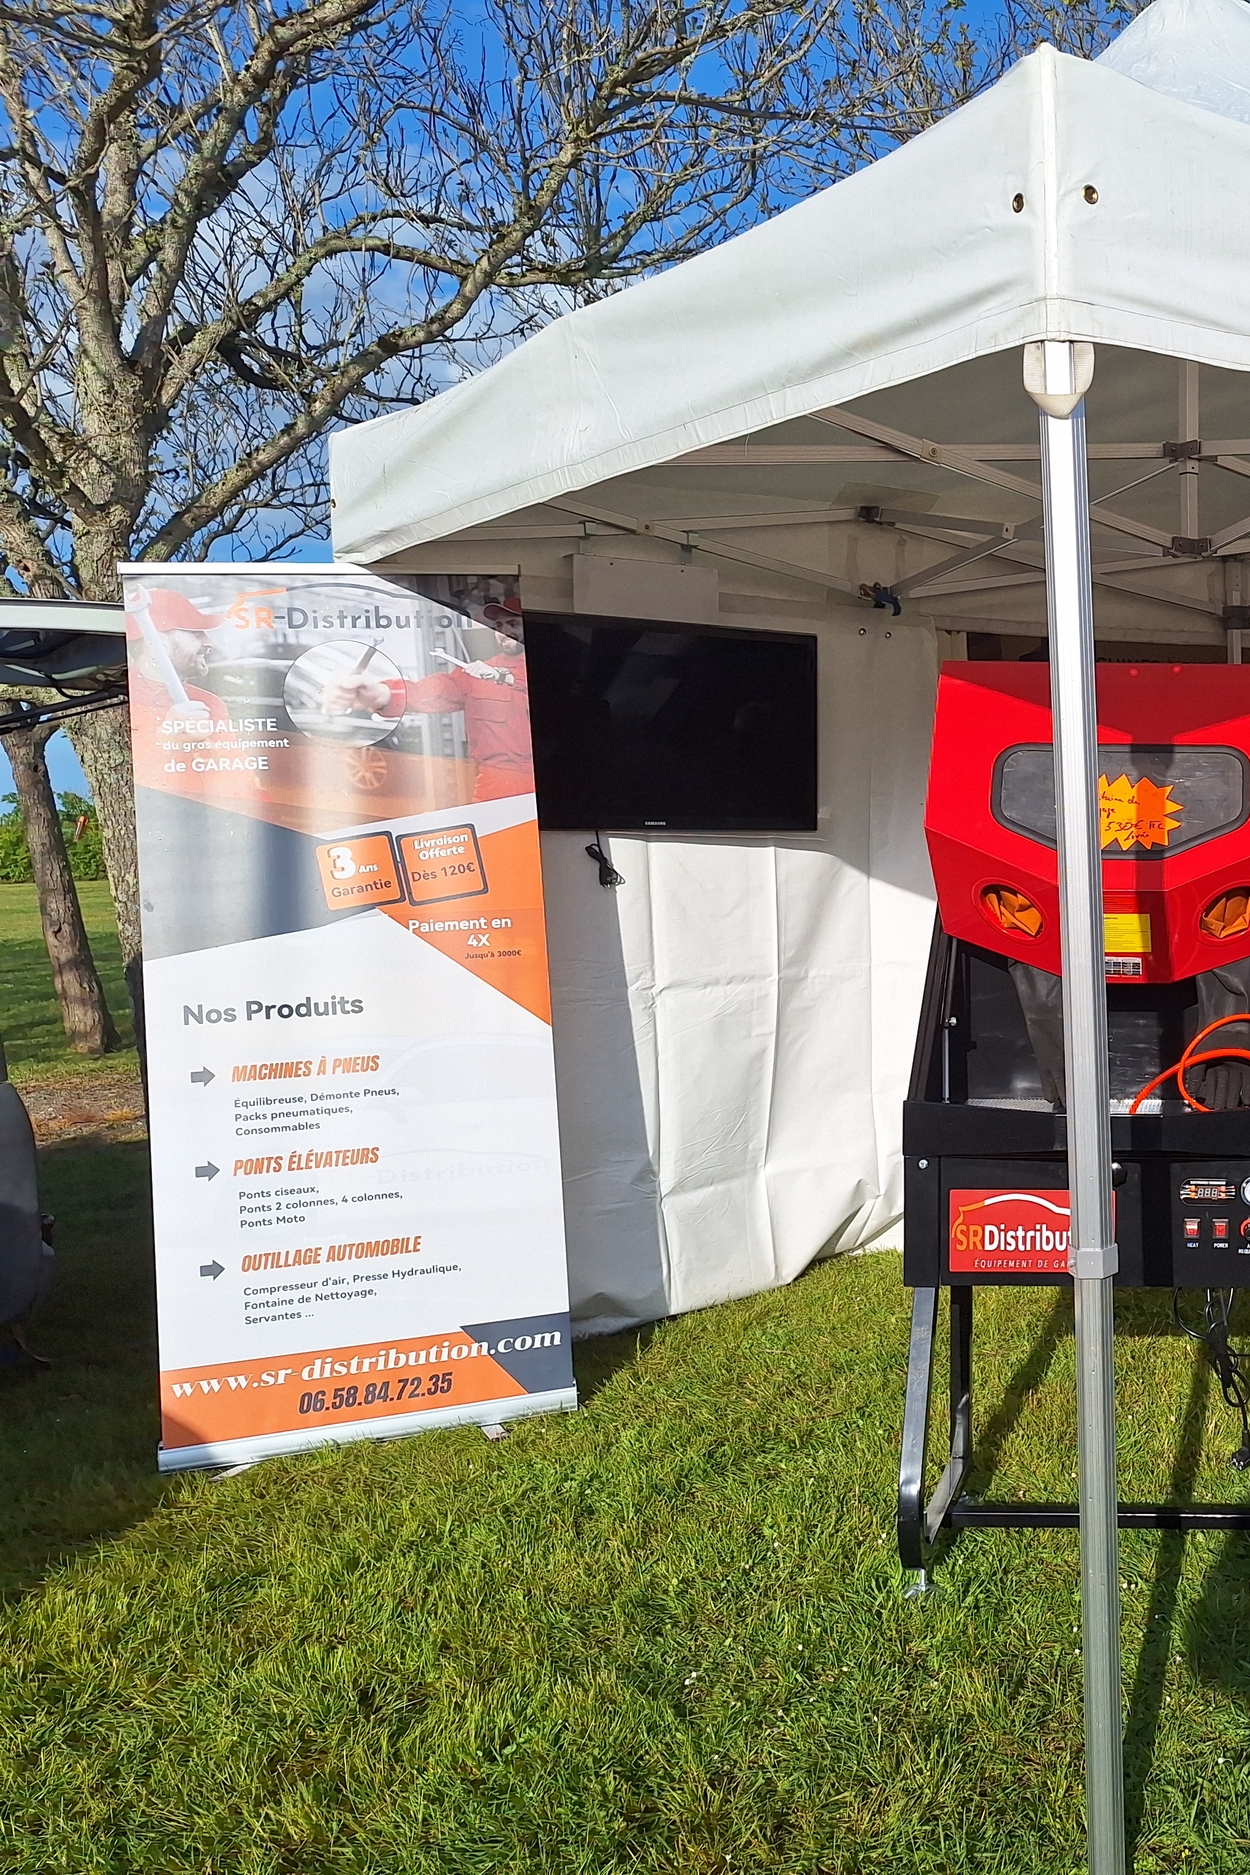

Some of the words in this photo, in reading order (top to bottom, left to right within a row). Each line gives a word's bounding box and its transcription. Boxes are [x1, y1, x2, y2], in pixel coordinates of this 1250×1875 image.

[233, 605, 473, 630] SR-Distribution
[161, 716, 278, 734] SPÉCIALISTE
[163, 740, 179, 751] du
[183, 741, 212, 753] gros
[214, 737, 290, 751] équipement
[164, 759, 186, 773] de
[191, 756, 270, 772] GARAGE
[413, 833, 468, 850] Livraison
[418, 845, 466, 861] Offerte
[328, 846, 356, 880] 3
[358, 863, 379, 874] Ans
[411, 868, 438, 883] Dès
[441, 862, 476, 877] 120€
[331, 879, 392, 898] Garantie
[408, 916, 488, 933] Paiement
[491, 917, 512, 928] en
[467, 933, 491, 948] 4X
[465, 951, 495, 960] Jusqu'à
[497, 949, 522, 958] 3000€
[182, 1004, 237, 1026] Nos
[246, 995, 364, 1021] Produits
[231, 1060, 314, 1083] MACHINES
[316, 1055, 328, 1076] À
[332, 1054, 380, 1075] PNEUS
[234, 1095, 307, 1110] Équilibreuse,
[310, 1090, 361, 1103] Démonte
[363, 1087, 400, 1098] Pneus,
[235, 1110, 268, 1123] Packs
[270, 1104, 353, 1122] pneumatiques,
[235, 1121, 321, 1136] Consommables
[232, 1155, 284, 1177] PONTS
[287, 1146, 380, 1172] ÉLÉVATEURS
[238, 1189, 272, 1200] Ponts
[274, 1185, 320, 1197] ciseaux,
[239, 1204, 272, 1215] Ponts
[275, 1202, 283, 1211] 2
[285, 1197, 339, 1210] colonnes,
[341, 1195, 349, 1204] 4
[351, 1191, 403, 1203] colonnes,
[240, 1218, 273, 1229] Ponts
[276, 1215, 306, 1225] Moto
[955, 1224, 1071, 1251] SRDistribu
[241, 1247, 323, 1273] OUTILLAGE
[325, 1235, 422, 1263] AUTOMOBILE
[974, 1257, 1033, 1269] ÉQUIPEMENT
[1037, 1259, 1049, 1268] DE
[243, 1279, 319, 1297] Compresseur
[321, 1276, 350, 1288] d'air,
[352, 1272, 389, 1284] Presse
[392, 1263, 462, 1280] Hydraulique,
[244, 1297, 295, 1311] Fontaine
[297, 1294, 312, 1304] de
[315, 1287, 377, 1302] Nettoyage,
[244, 1310, 302, 1325] Servantes
[170, 1328, 563, 1399] www.sr-distribution.com
[298, 1372, 453, 1415] 06.58.84.72.35
